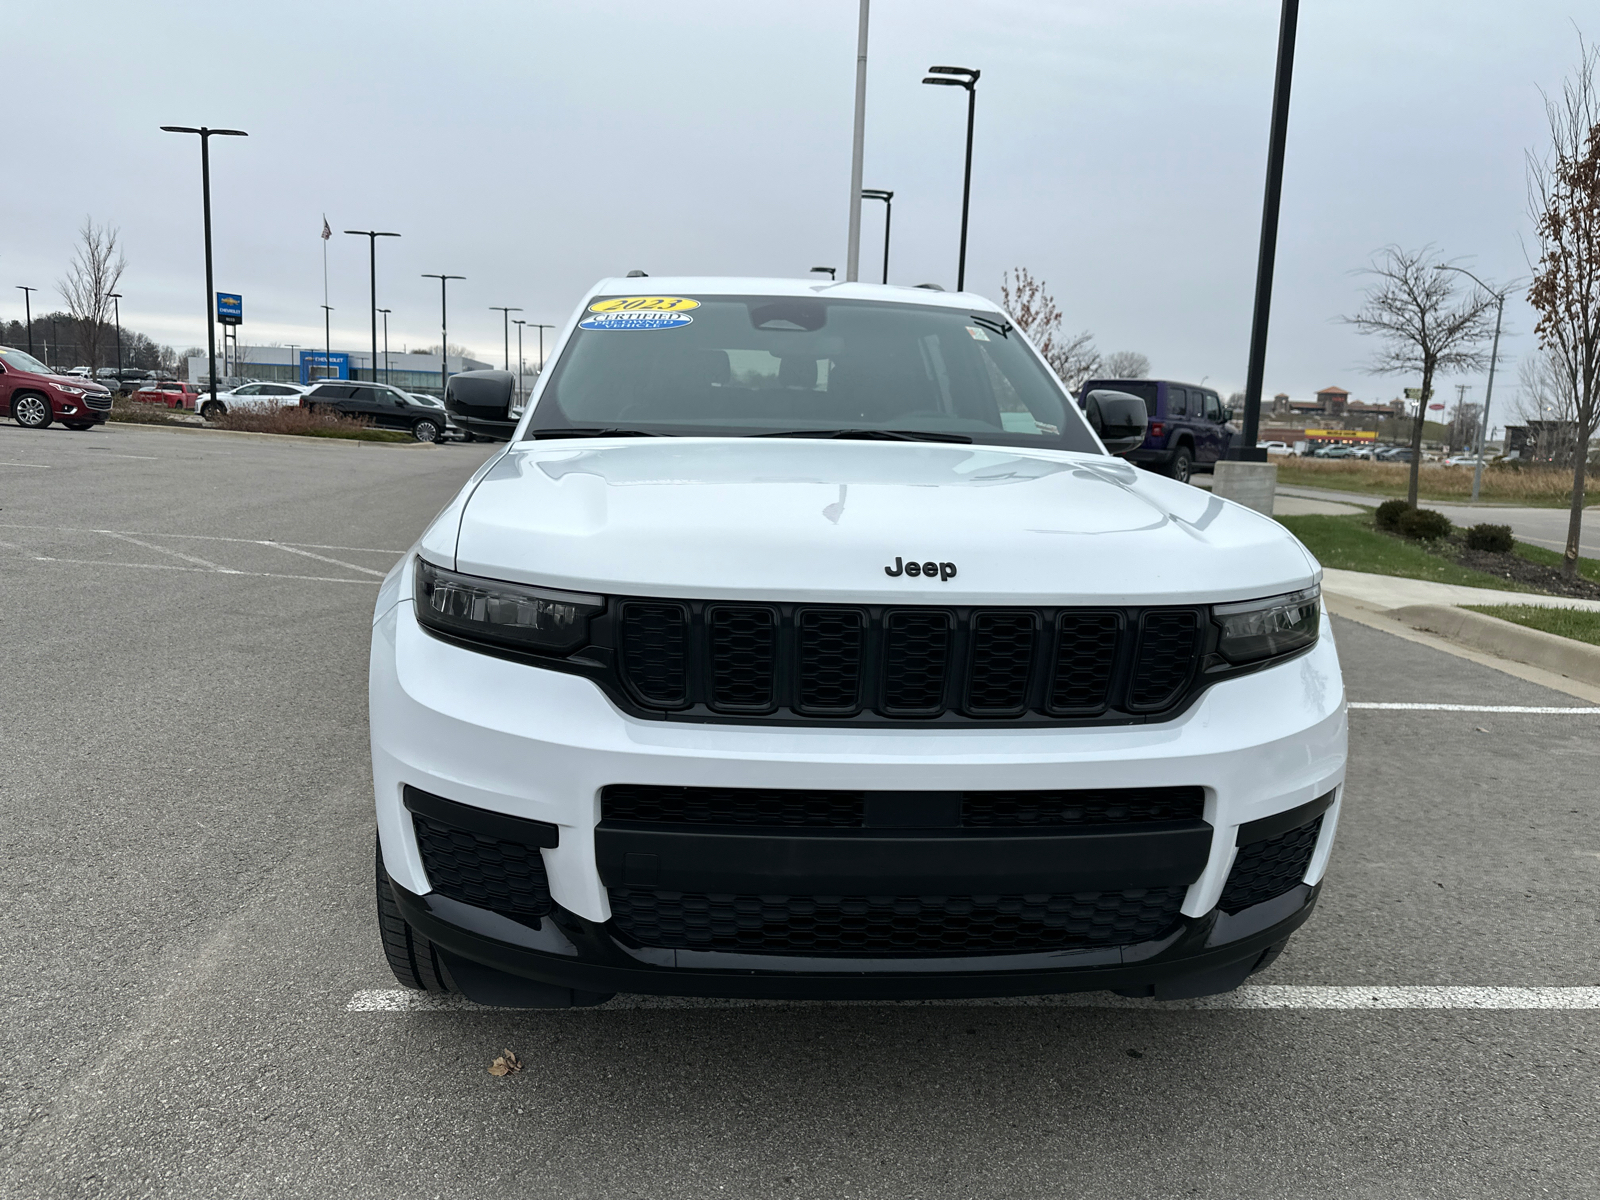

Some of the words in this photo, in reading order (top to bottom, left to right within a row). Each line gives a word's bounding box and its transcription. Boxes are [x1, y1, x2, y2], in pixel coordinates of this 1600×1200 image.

[604, 299, 683, 311] 2023
[219, 307, 241, 315] CHEVROLET
[593, 313, 681, 321] CERTIFIED
[884, 556, 958, 582] Jeep
